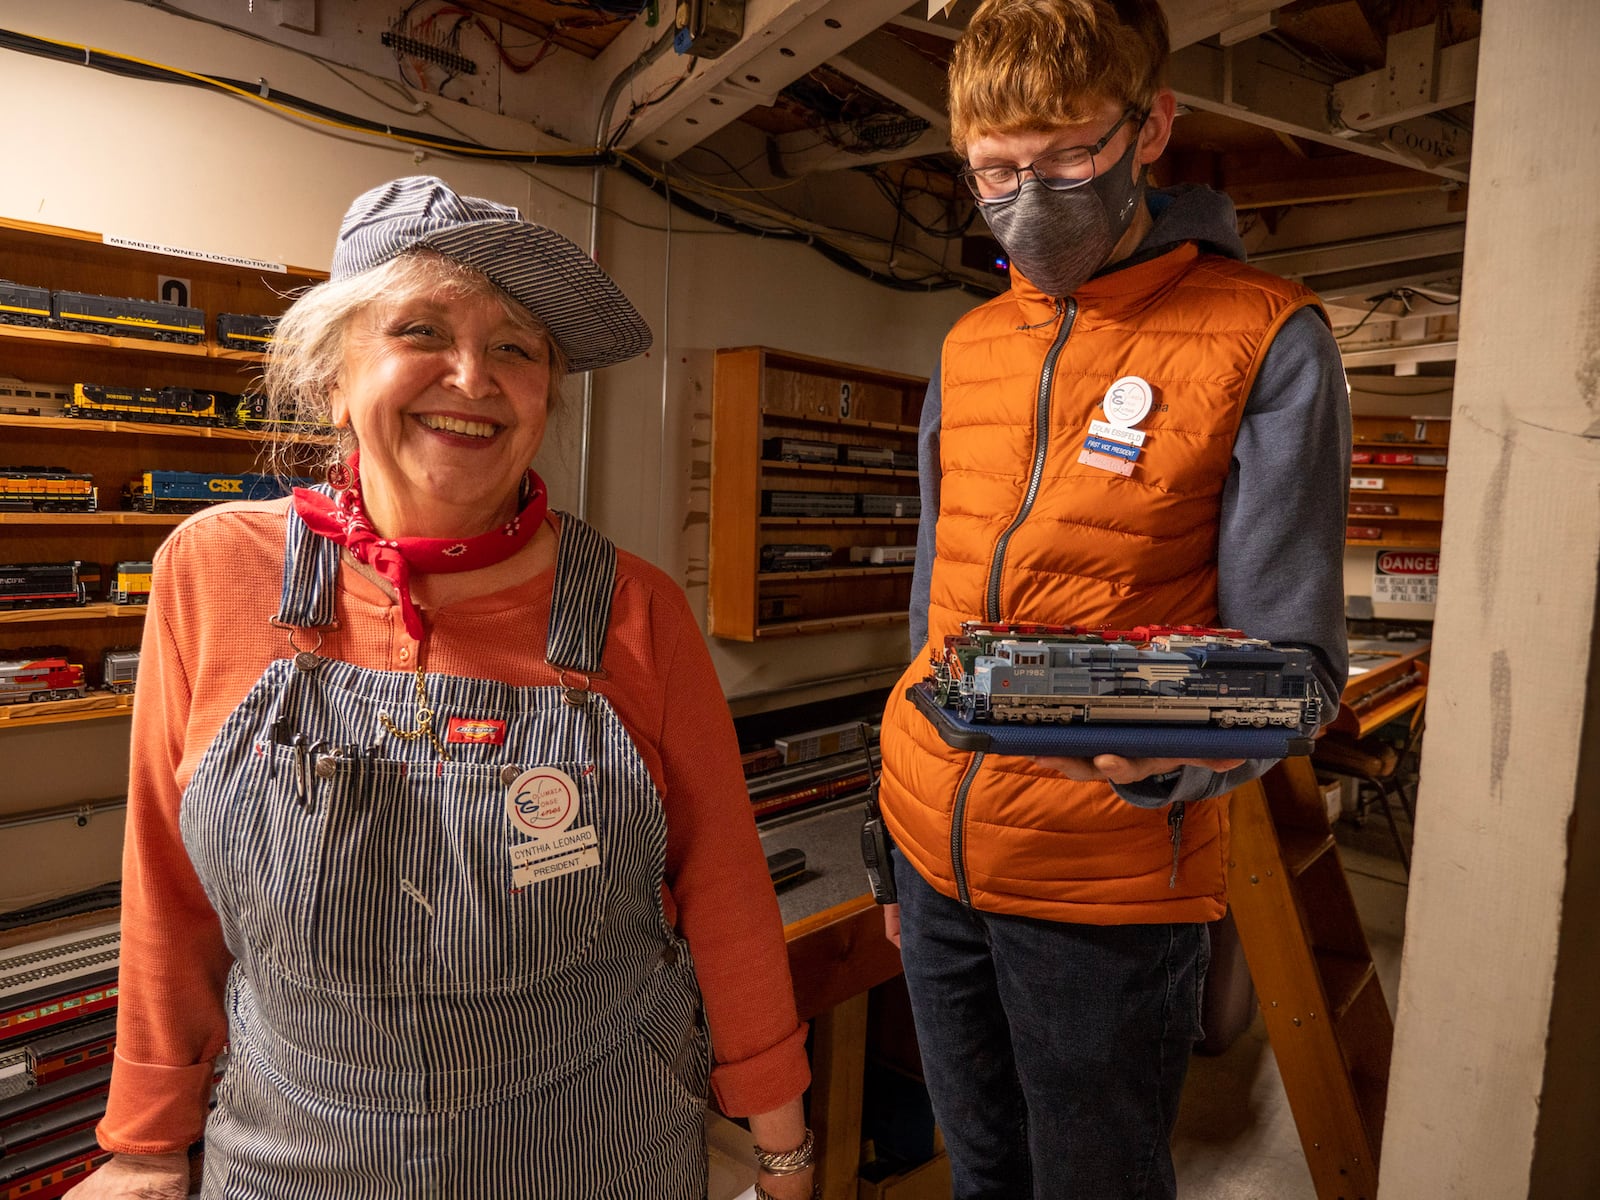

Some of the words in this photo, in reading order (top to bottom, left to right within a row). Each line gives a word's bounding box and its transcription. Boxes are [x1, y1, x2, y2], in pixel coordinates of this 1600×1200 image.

[110, 238, 160, 250] MEMBER
[164, 247, 203, 257] OWNED
[206, 254, 280, 270] LOCOMOTIVES
[841, 384, 850, 417] 3
[1416, 420, 1425, 438] 7
[1088, 440, 1101, 448] FIRST
[1101, 443, 1112, 451] VICE
[1111, 446, 1136, 457] PRESIDENT
[208, 479, 244, 492] CSX
[1013, 669, 1025, 677] UP
[1026, 669, 1045, 677] 1982
[514, 843, 551, 860] CYNTHIA
[553, 831, 592, 849] LEONARD
[533, 857, 580, 877] PRESIDENT
